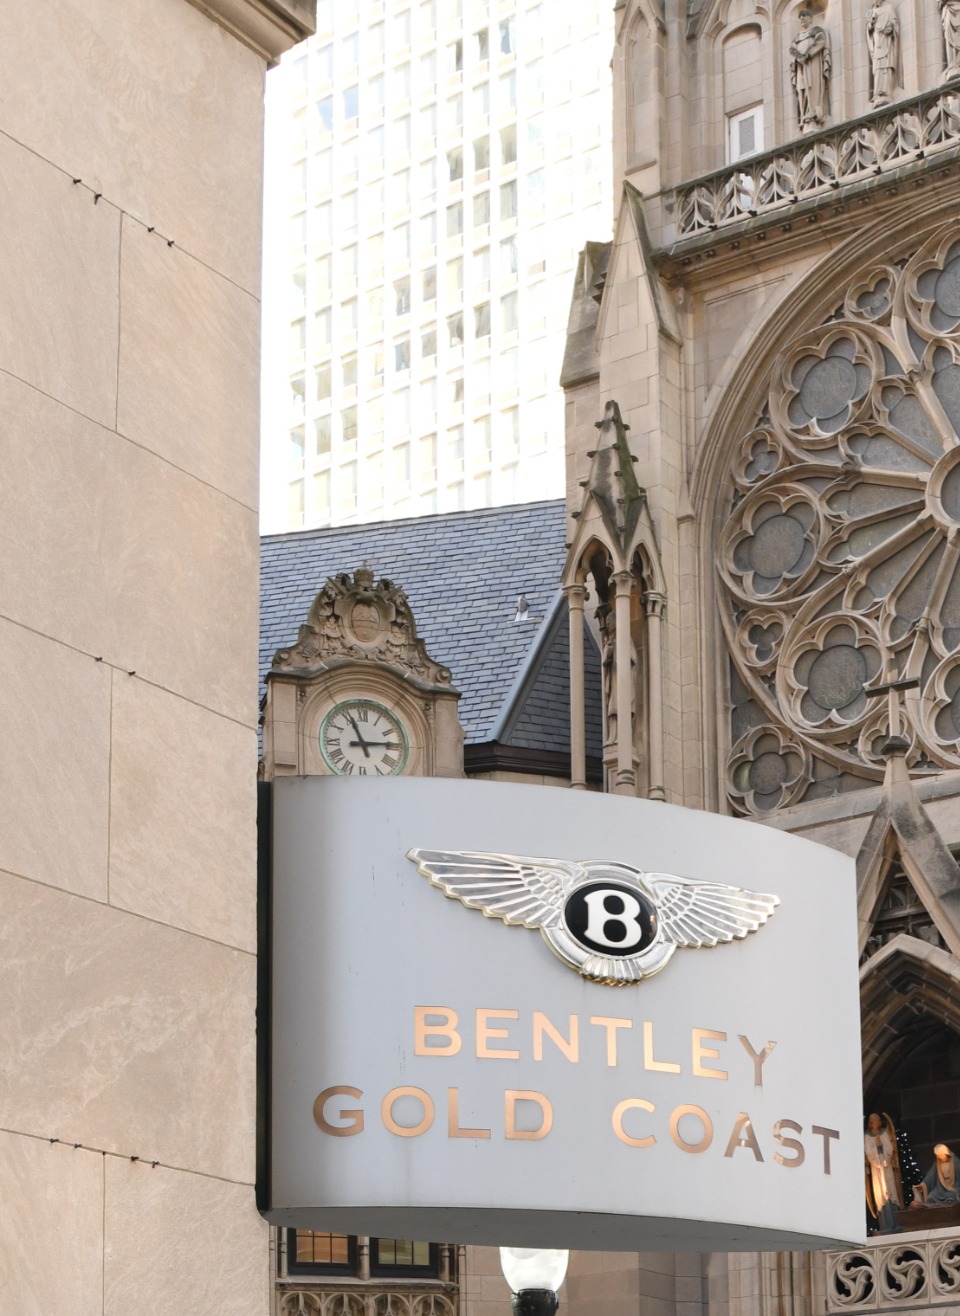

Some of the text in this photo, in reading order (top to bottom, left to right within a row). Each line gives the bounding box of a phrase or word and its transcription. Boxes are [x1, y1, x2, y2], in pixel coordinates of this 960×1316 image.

[586, 888, 643, 950] B
[414, 1005, 778, 1087] BENTLEY
[312, 1085, 841, 1176] GOLD COAST
